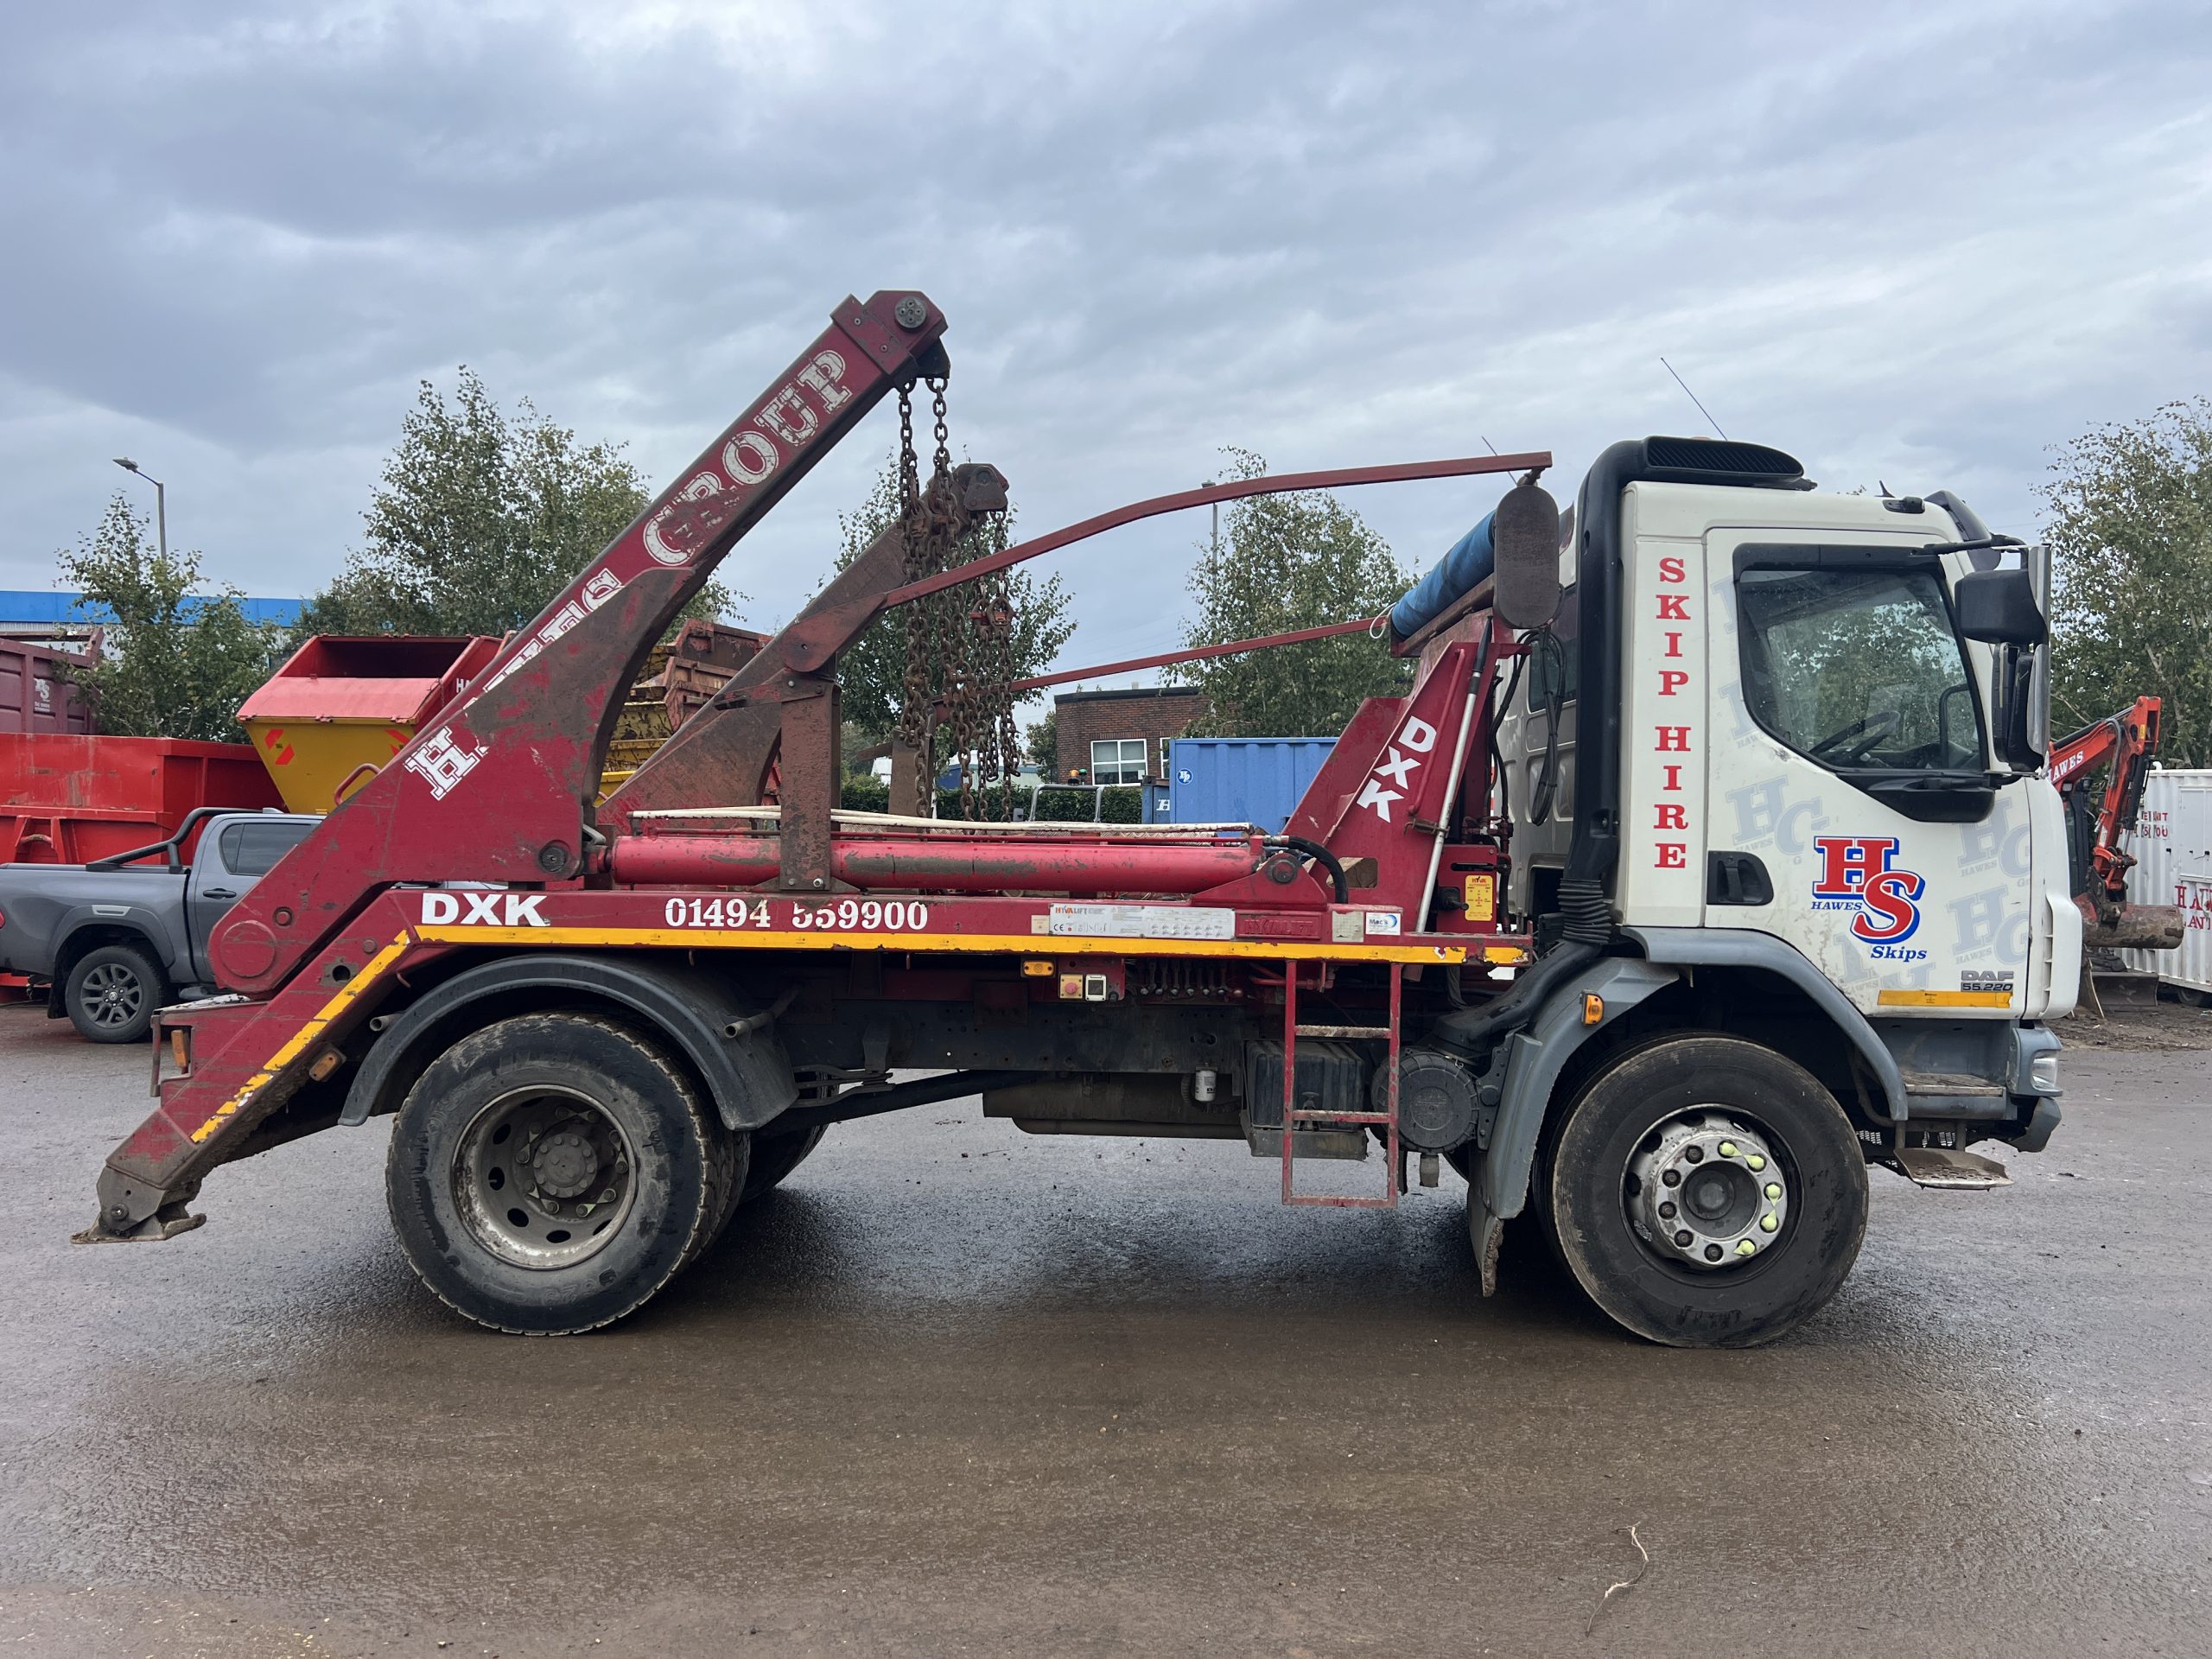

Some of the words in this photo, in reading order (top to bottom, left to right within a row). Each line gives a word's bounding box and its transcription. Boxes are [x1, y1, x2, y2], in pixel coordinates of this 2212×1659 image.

[1656, 557, 1691, 696] SKIP
[1356, 715, 1437, 823] DXK
[1654, 726, 1691, 868] HIRE
[1811, 900, 1863, 912] HAWES
[1812, 836, 1926, 945] HS
[422, 893, 550, 926] DXK
[664, 898, 771, 928] 01494
[1870, 945, 1928, 963] Skips
[1961, 969, 2014, 982] DAF
[1961, 982, 2014, 992] 55.220
